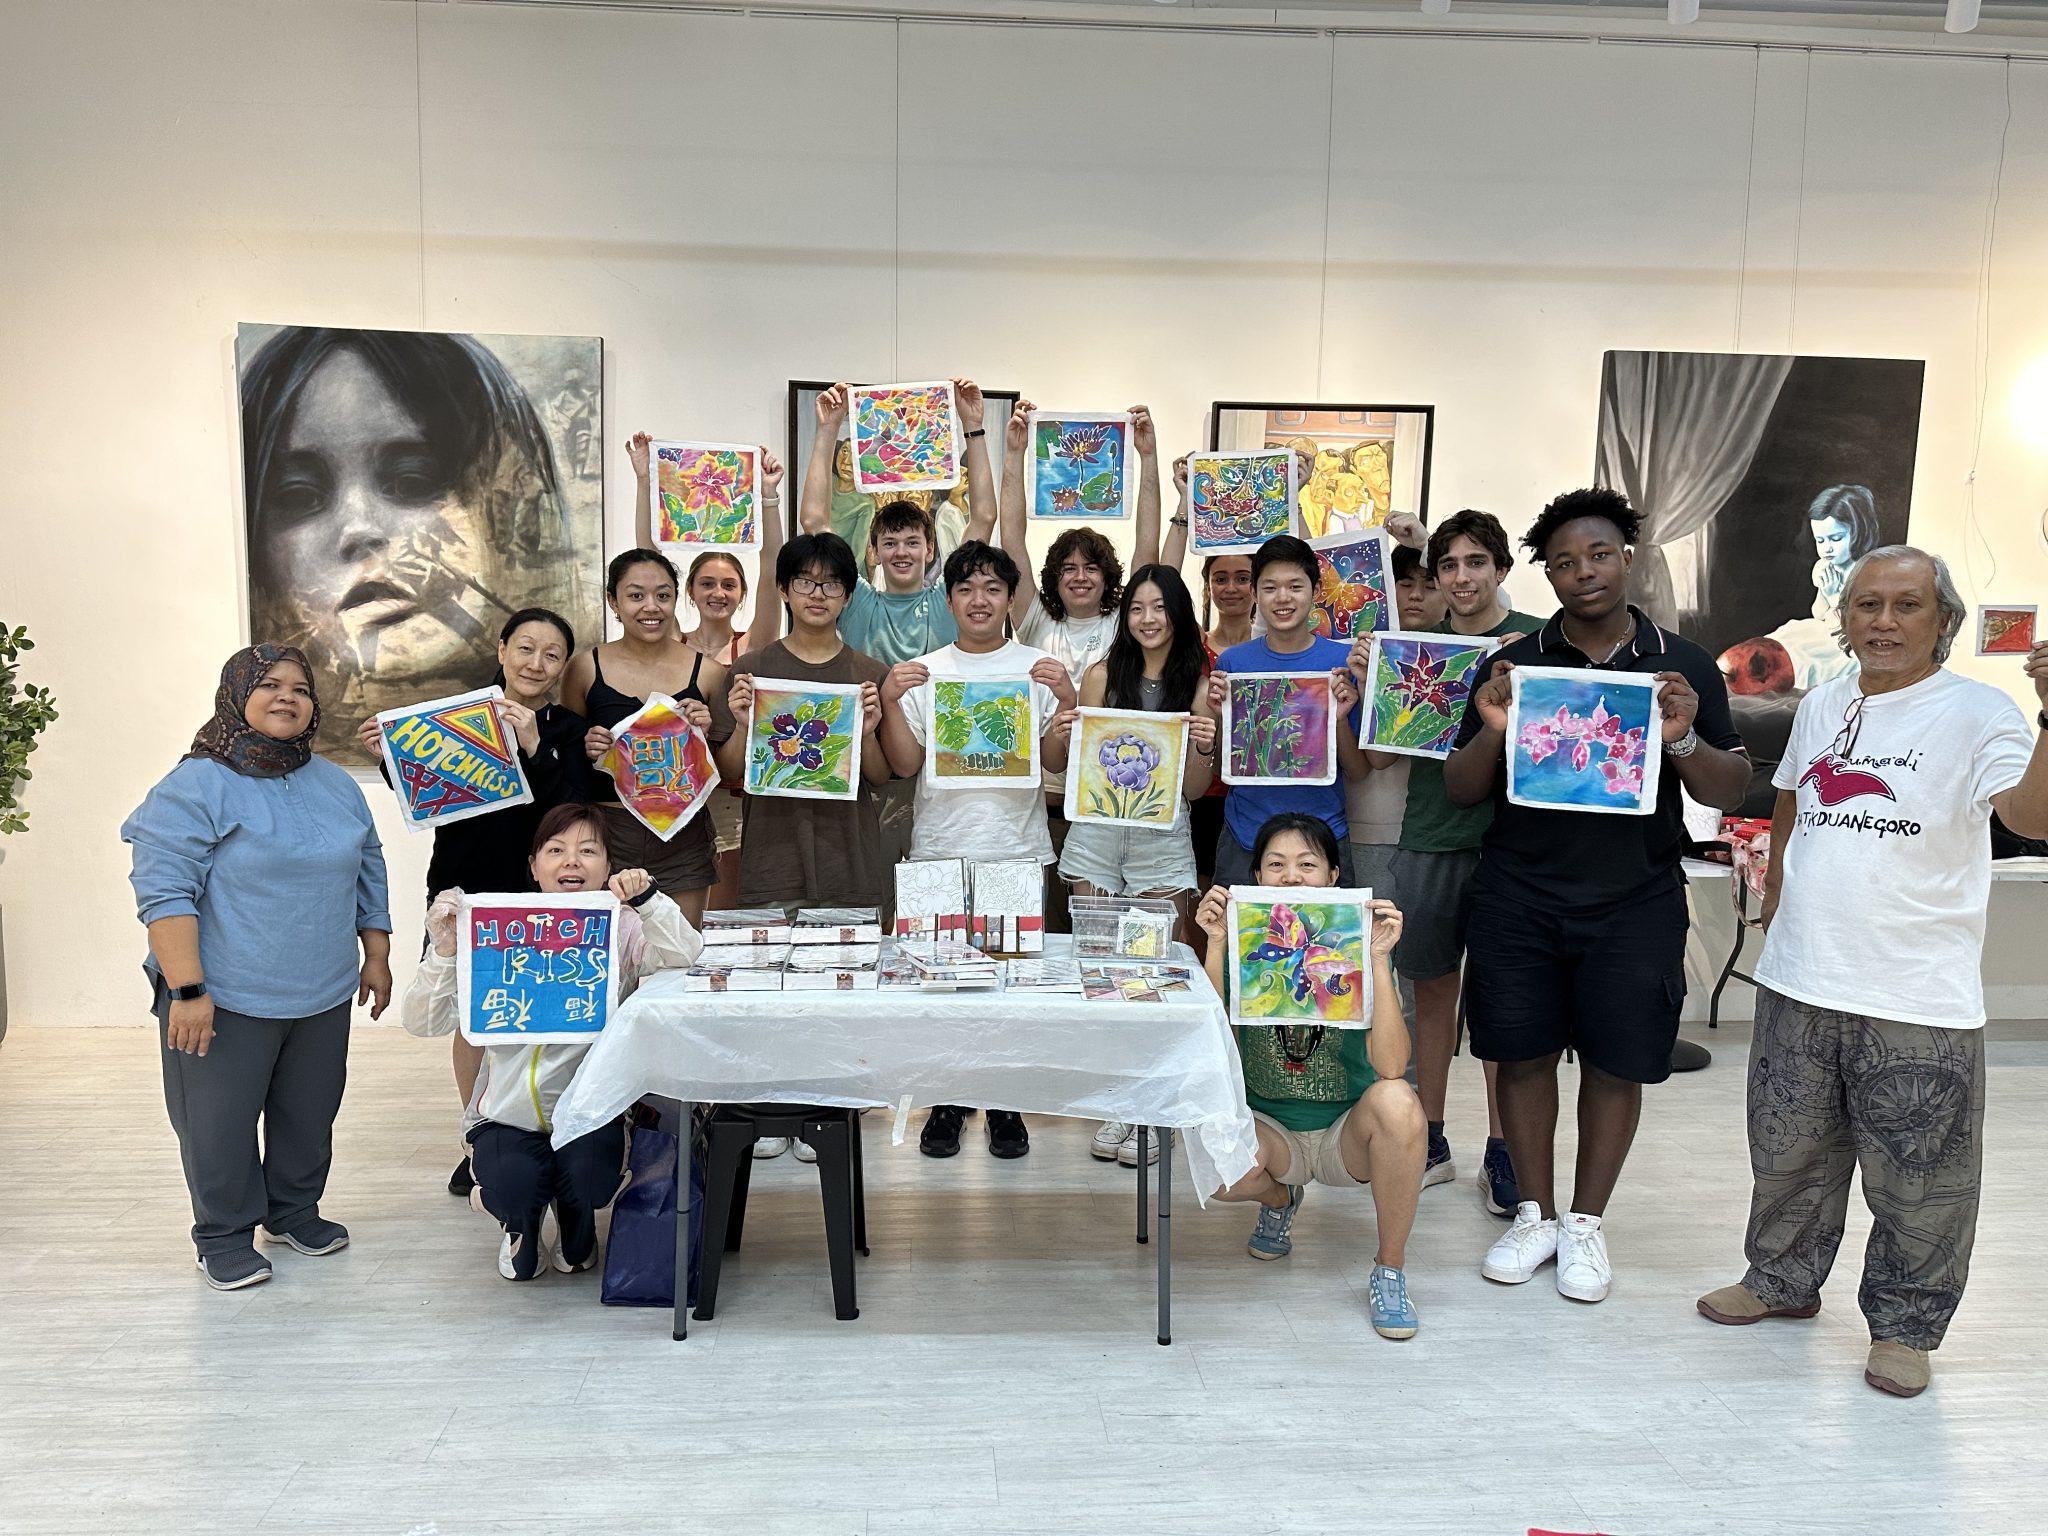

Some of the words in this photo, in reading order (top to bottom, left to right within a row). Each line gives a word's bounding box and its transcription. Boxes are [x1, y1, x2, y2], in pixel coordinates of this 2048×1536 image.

[389, 716, 518, 797] HOTCHKISS
[1843, 747, 1924, 772] umadi
[399, 758, 487, 817] 中文
[475, 913, 608, 946] HOTCH
[503, 947, 607, 986] KISS
